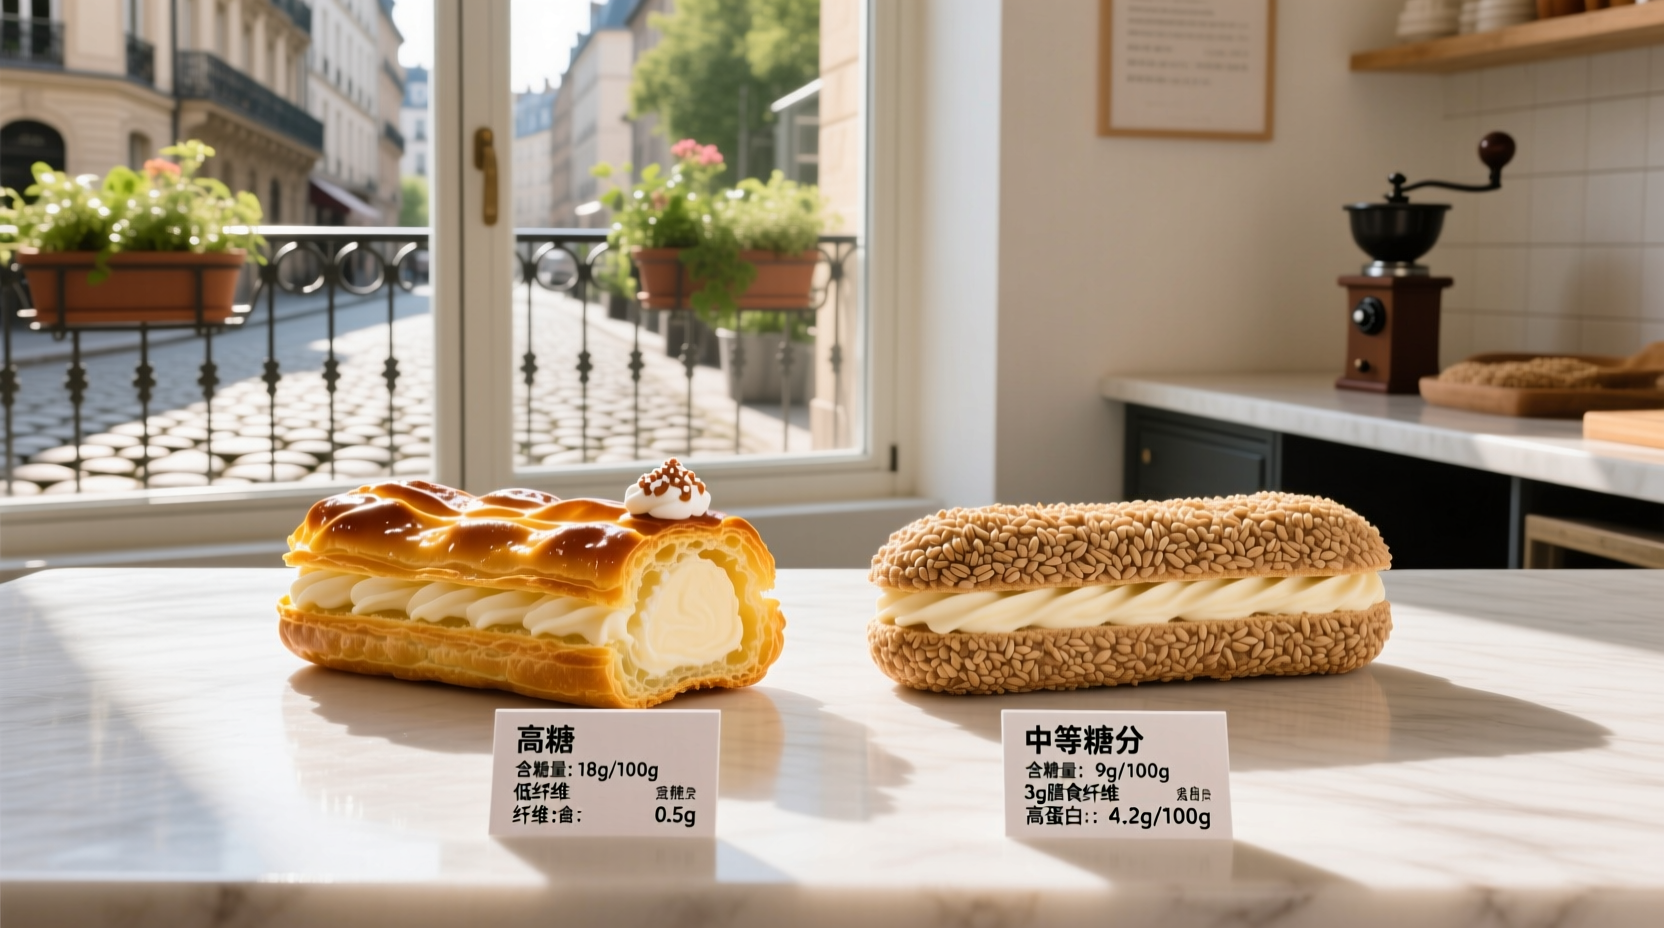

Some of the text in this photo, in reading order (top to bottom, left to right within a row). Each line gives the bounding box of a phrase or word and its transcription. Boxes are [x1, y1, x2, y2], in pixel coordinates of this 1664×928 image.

[517, 724, 575, 754] 高糖
[1025, 724, 1144, 755] 中等糖分
[578, 760, 659, 782] 18g/100g
[1095, 762, 1170, 783] 9g/100g
[513, 782, 571, 801] 低纤维
[655, 805, 696, 828] 0.5g
[1108, 806, 1211, 830] 4.2g/100g
